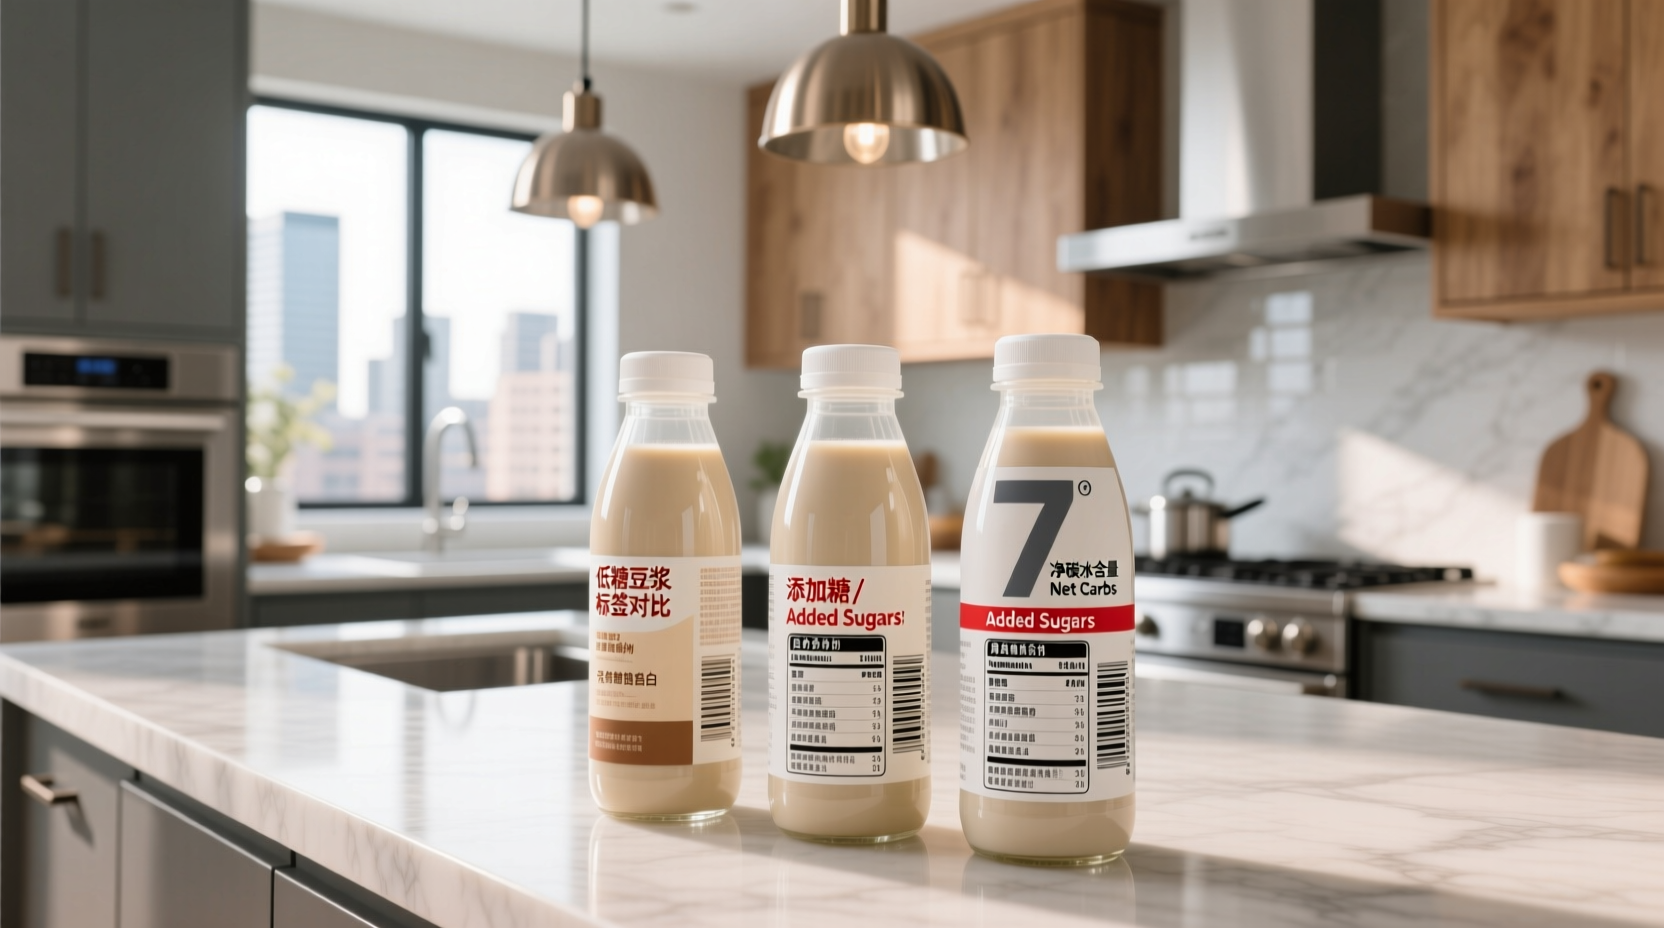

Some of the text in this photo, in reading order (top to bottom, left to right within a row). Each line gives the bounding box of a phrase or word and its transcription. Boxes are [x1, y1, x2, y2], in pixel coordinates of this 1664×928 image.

[993, 480, 1074, 597] 7
[596, 566, 672, 591] 低糖豆浆
[1050, 580, 1118, 596] Net Carbs
[596, 592, 671, 618] 标签对比
[786, 607, 839, 627] Added
[985, 610, 1096, 633] Added Sugars
